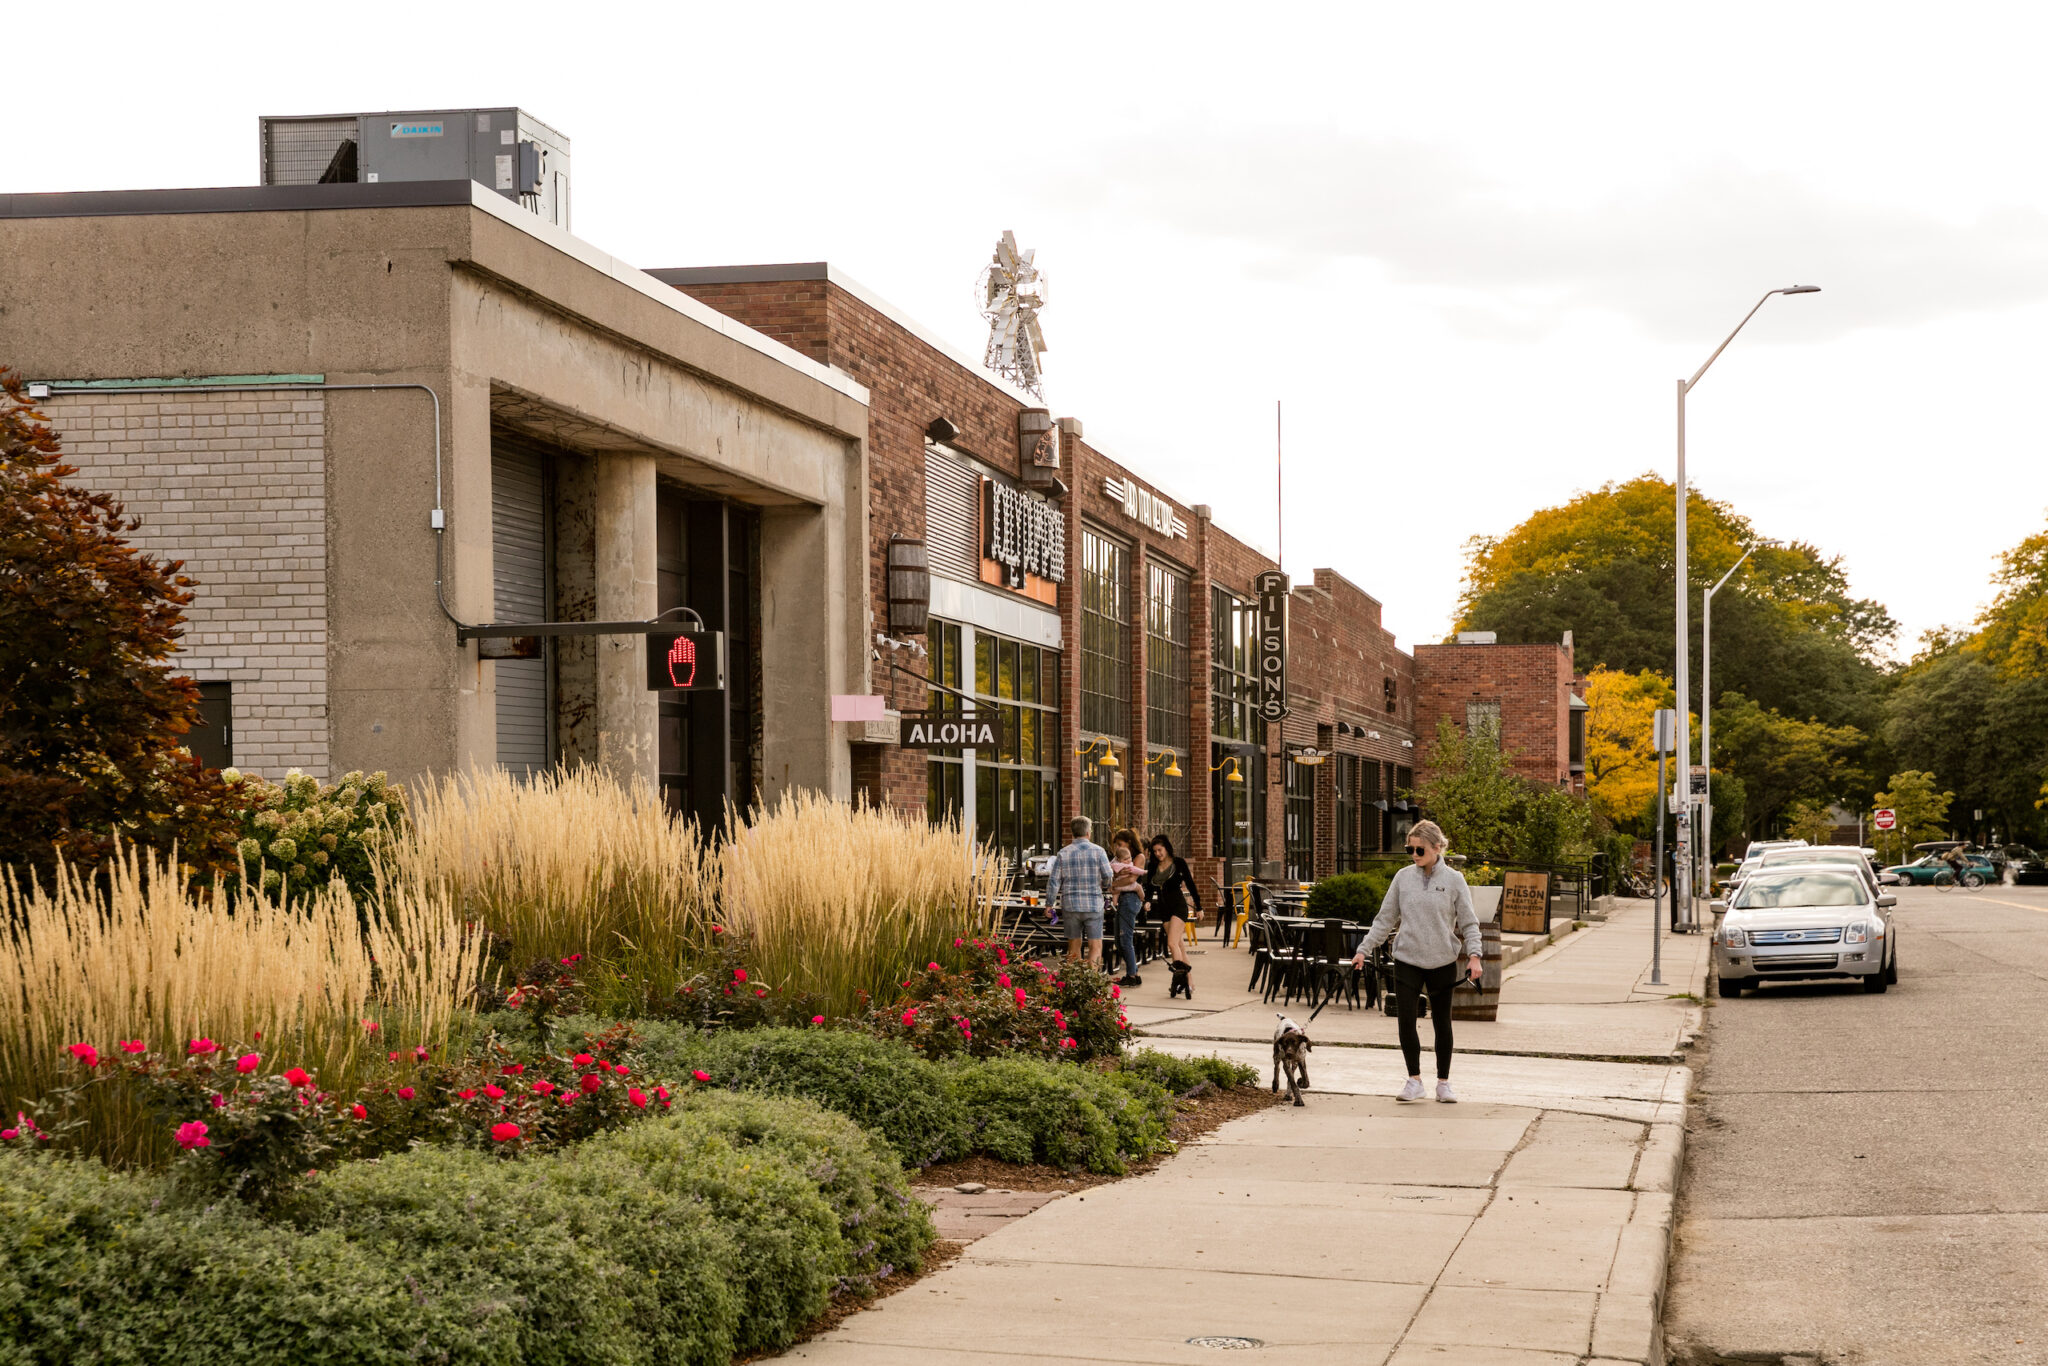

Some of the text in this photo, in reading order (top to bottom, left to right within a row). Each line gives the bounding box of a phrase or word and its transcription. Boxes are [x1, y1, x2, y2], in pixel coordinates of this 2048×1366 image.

[402, 125, 442, 134] DAIKIN
[1263, 575, 1282, 716] FILSON'S
[908, 723, 995, 744] ALOHA
[1506, 888, 1544, 900] FILSON
